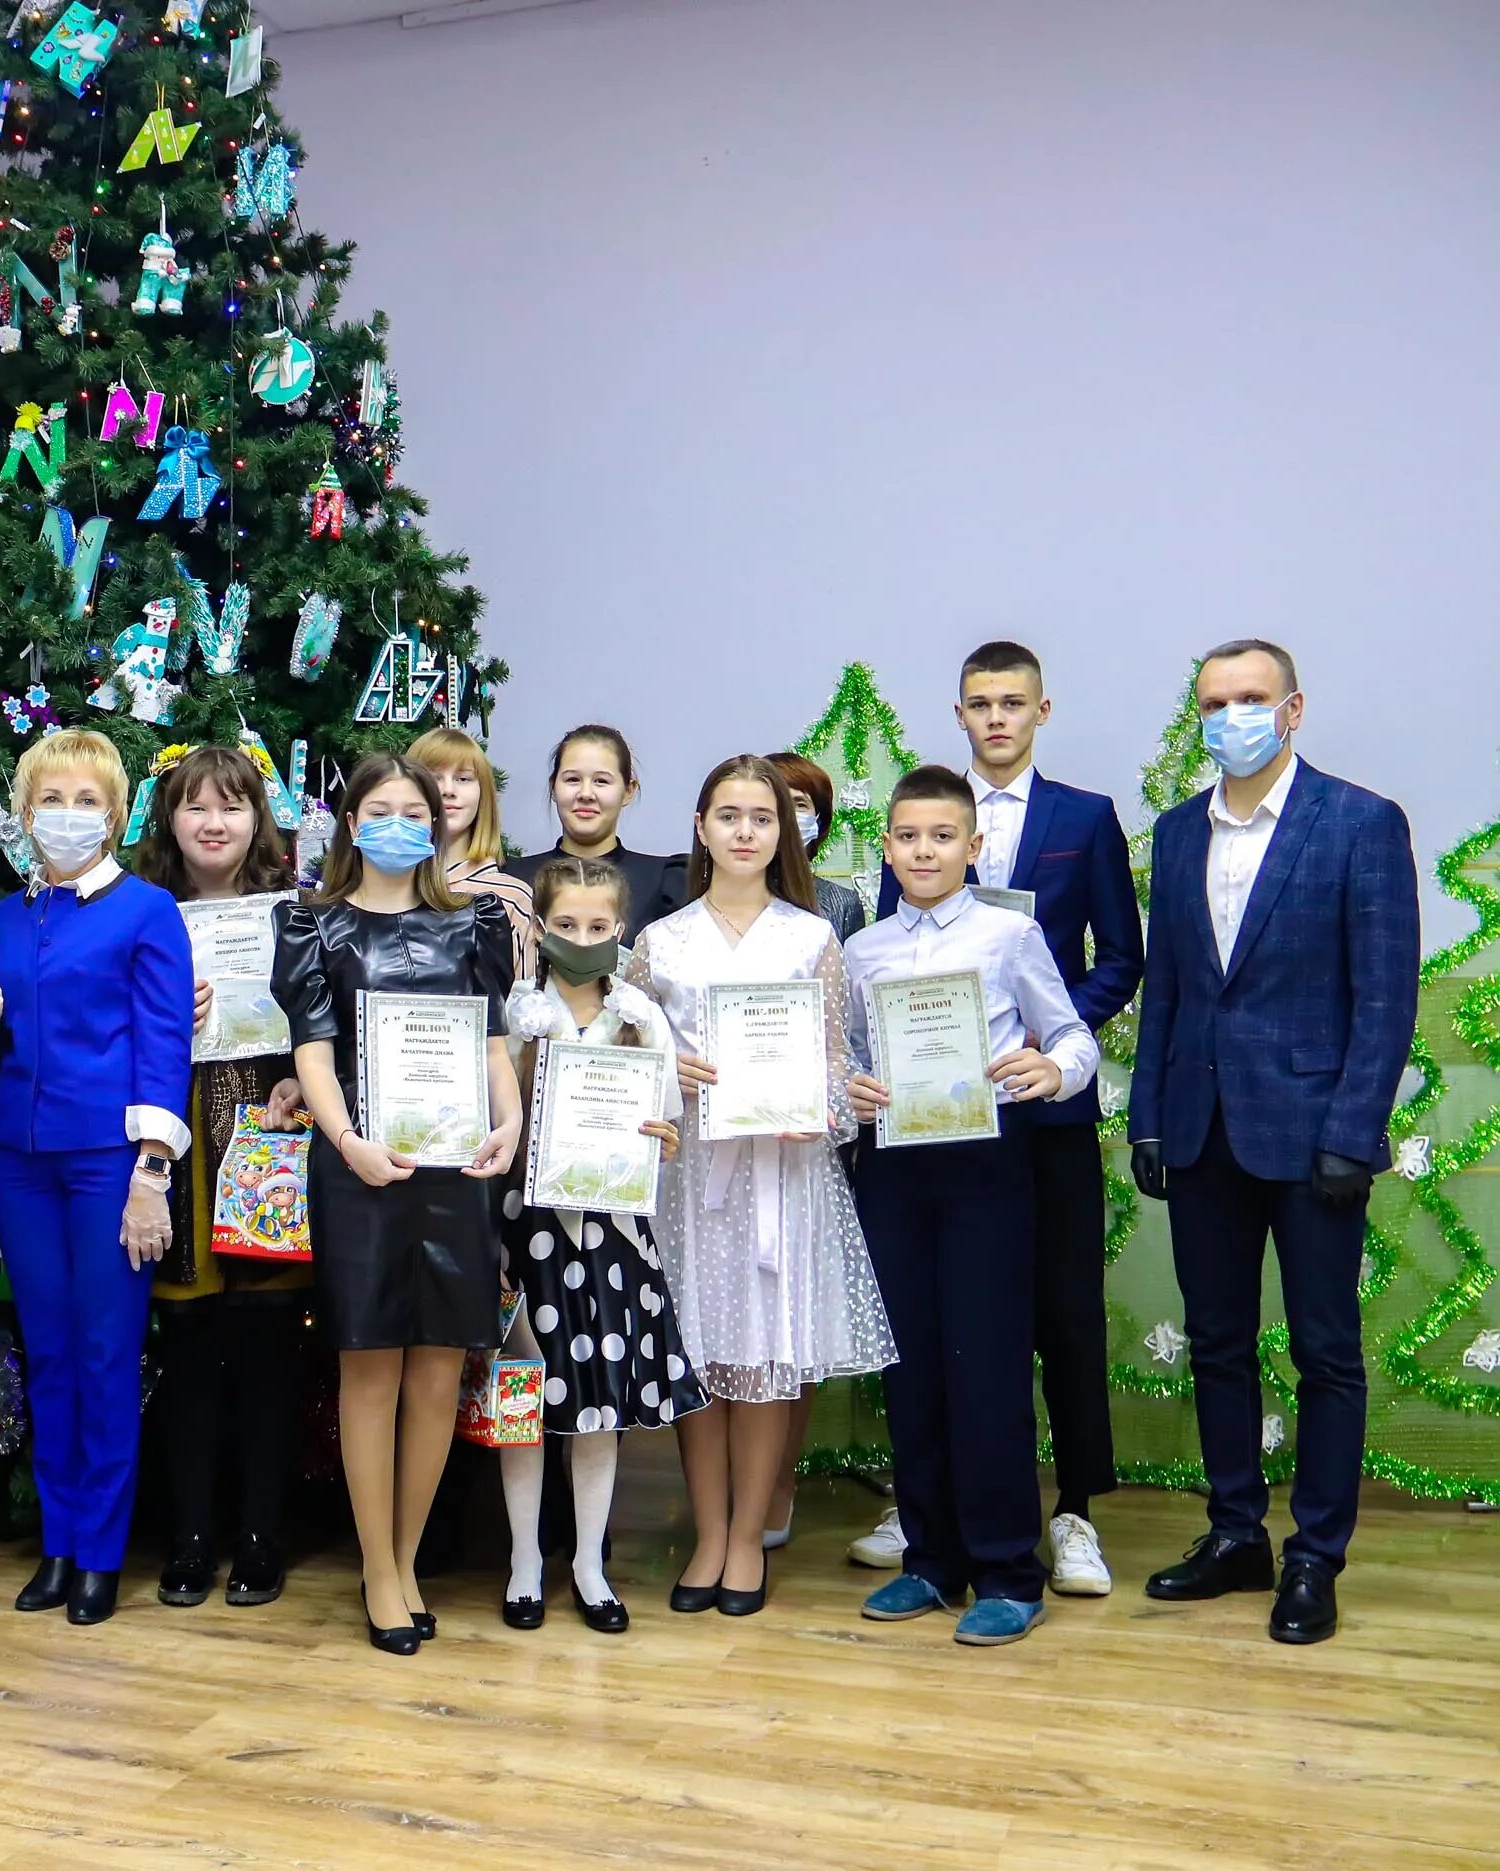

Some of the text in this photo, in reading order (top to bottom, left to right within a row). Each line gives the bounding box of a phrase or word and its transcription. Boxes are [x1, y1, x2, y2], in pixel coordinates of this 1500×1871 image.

[215, 936, 259, 945] НАГРАЖДАЕТСЯ
[908, 999, 953, 1013] ДИПЛОМ
[402, 1023, 451, 1033] ДИПЛОМ
